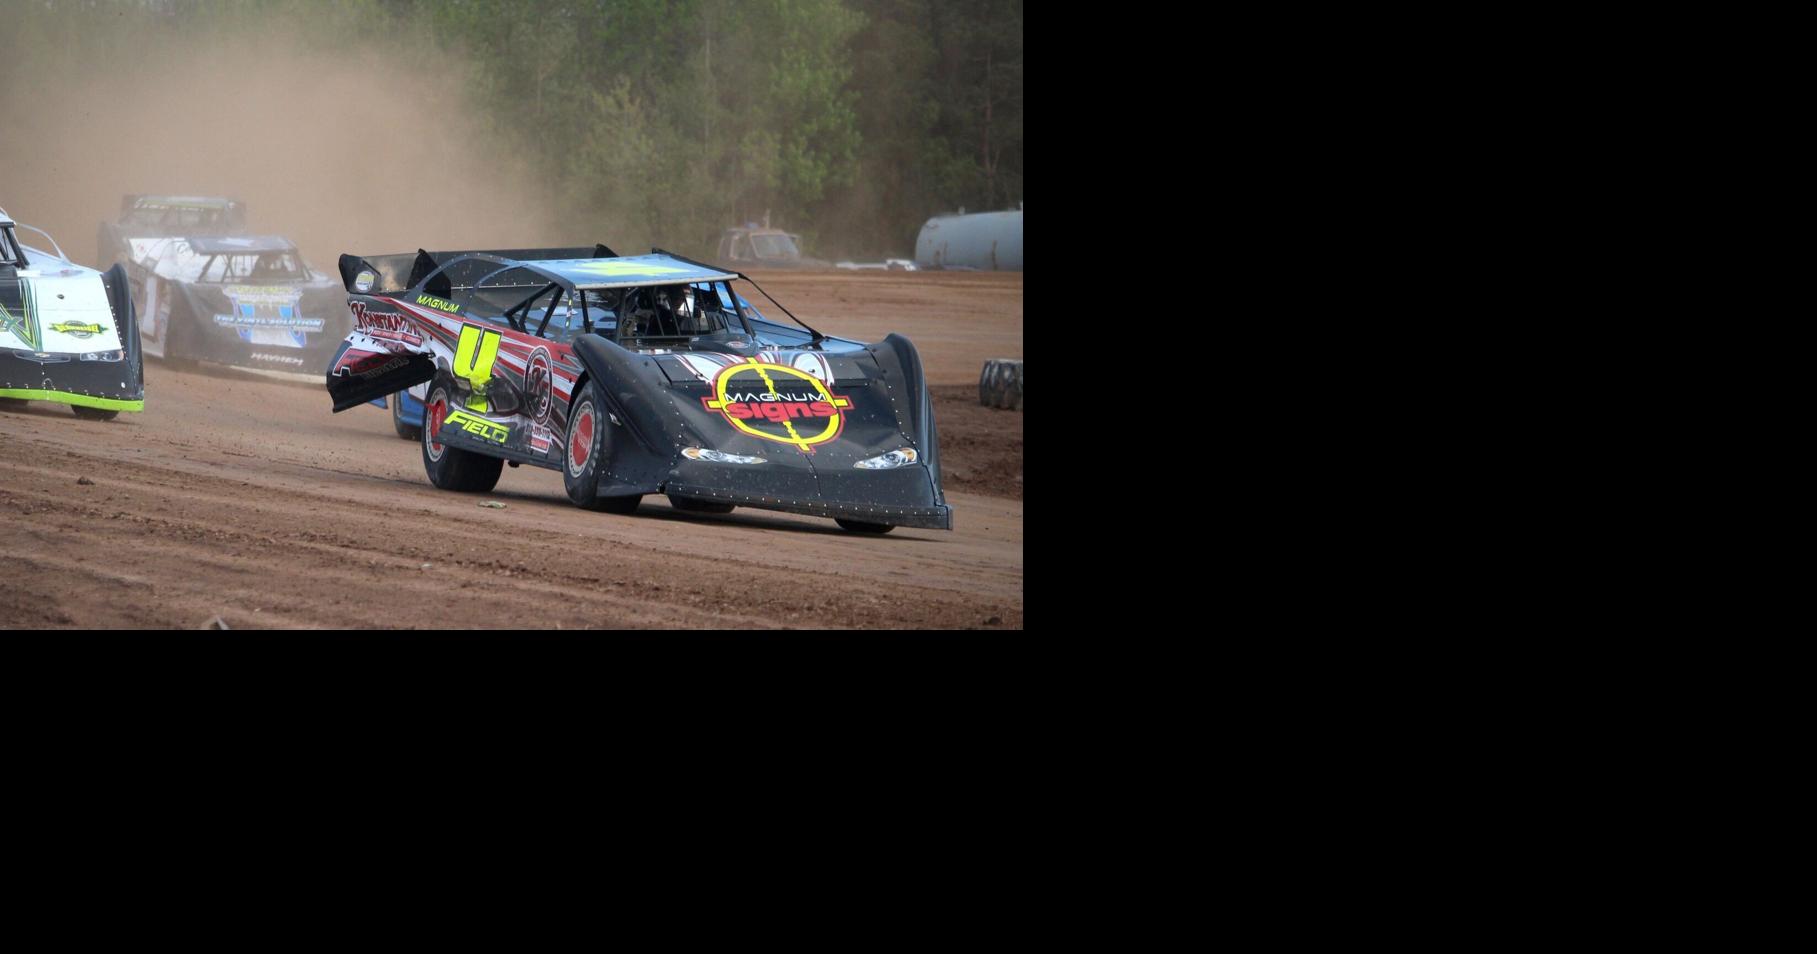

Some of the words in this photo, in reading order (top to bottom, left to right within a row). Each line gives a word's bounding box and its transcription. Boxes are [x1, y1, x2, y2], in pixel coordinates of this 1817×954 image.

[416, 295, 459, 312] MAGNUM
[250, 352, 304, 366] MAYHEM
[723, 392, 827, 402] MAGNUM
[725, 401, 839, 423] signs
[443, 410, 510, 443] FIELD
